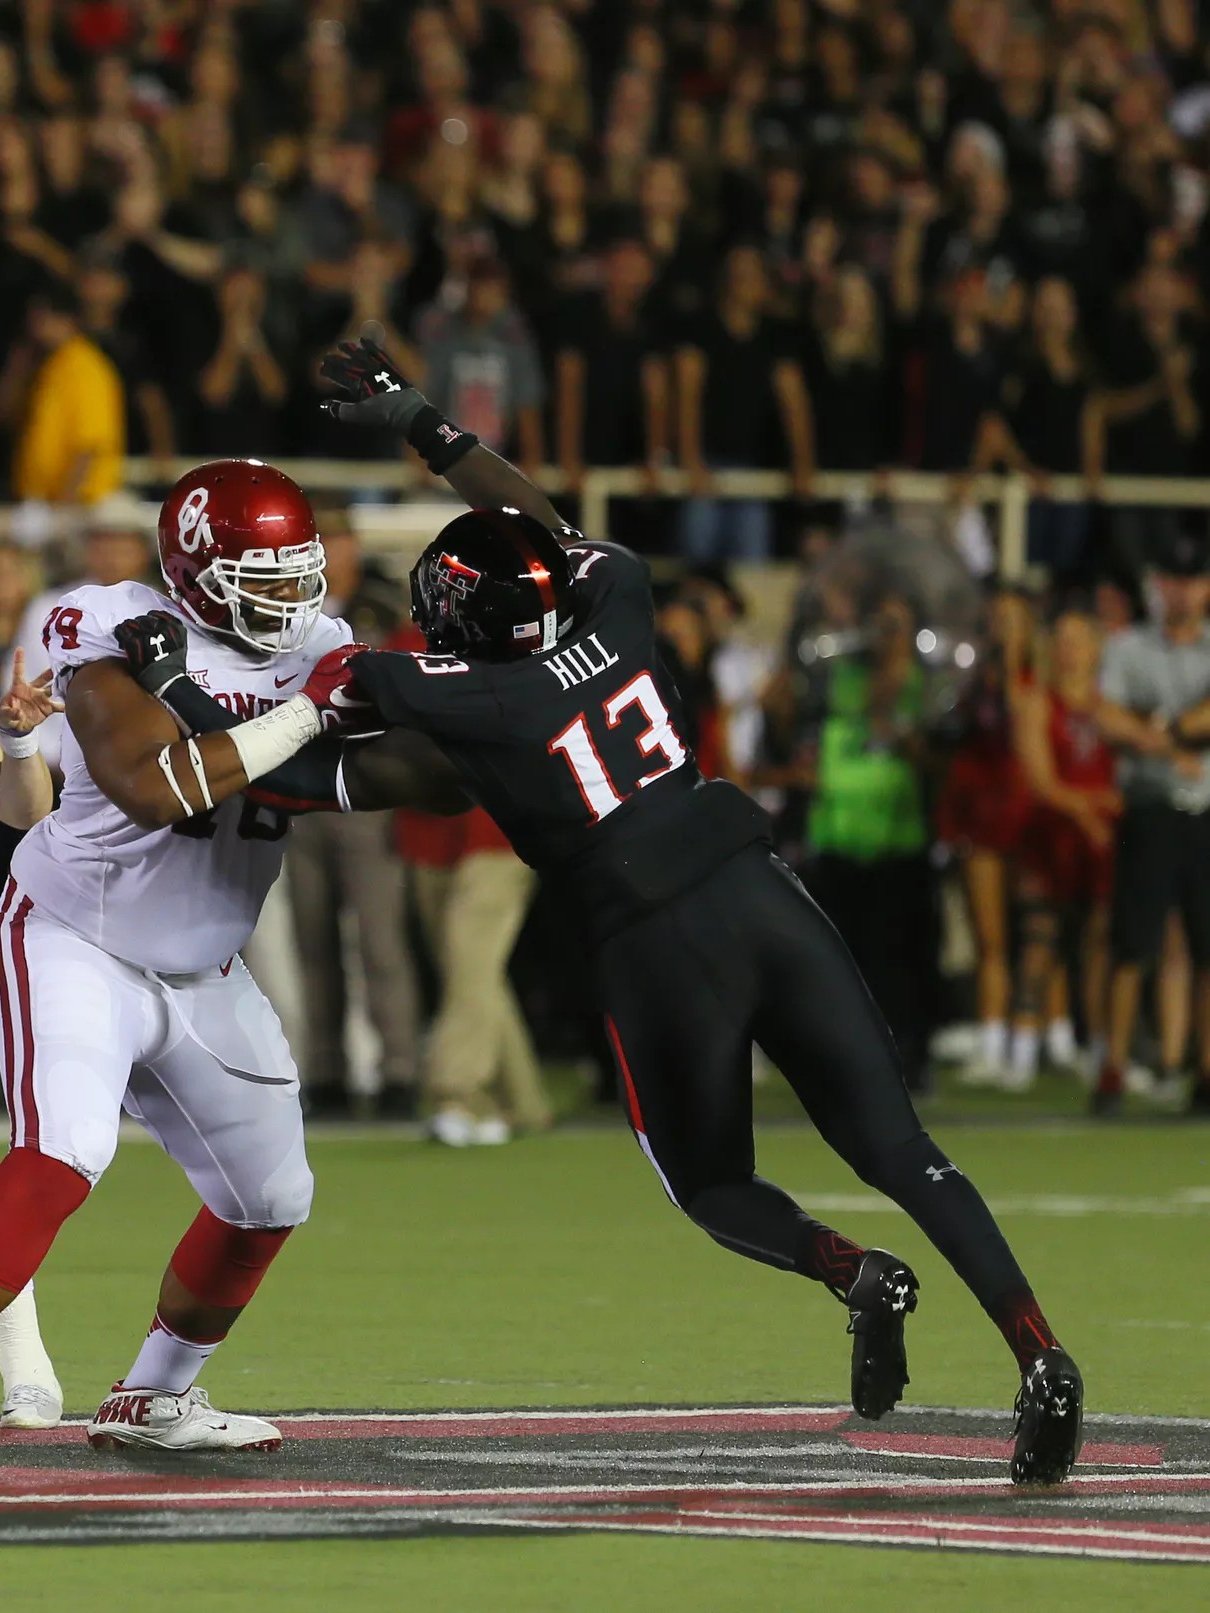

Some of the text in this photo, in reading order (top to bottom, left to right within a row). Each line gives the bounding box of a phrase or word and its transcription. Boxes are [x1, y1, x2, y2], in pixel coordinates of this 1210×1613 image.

[542, 632, 620, 691] HILL
[548, 669, 687, 828] 13
[93, 1396, 155, 1427] NIKE
